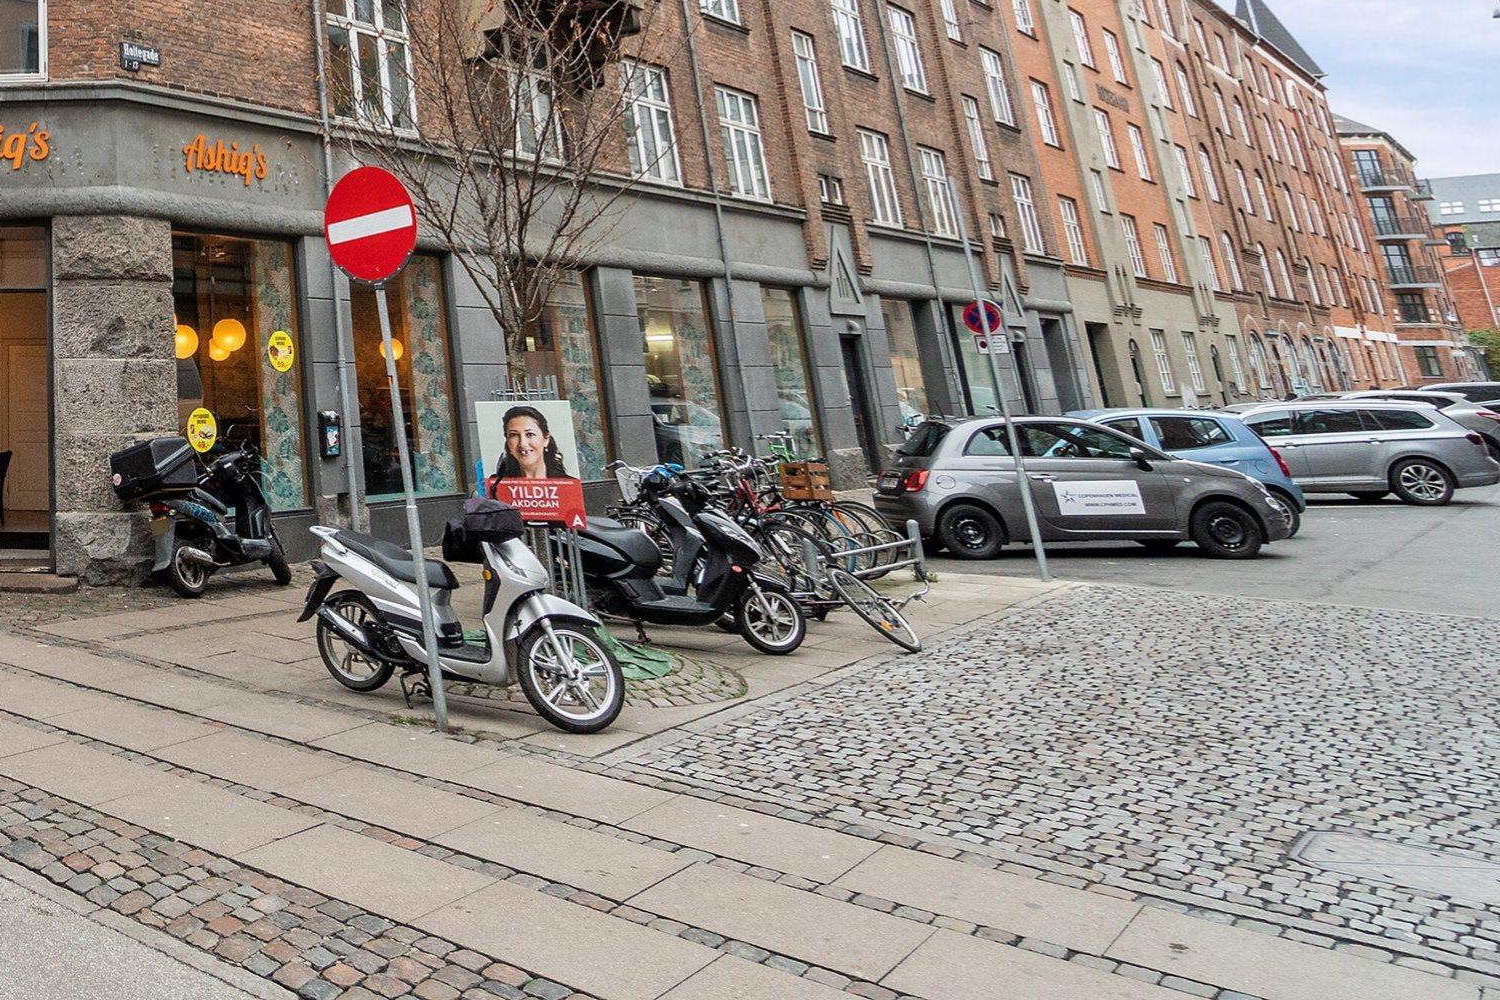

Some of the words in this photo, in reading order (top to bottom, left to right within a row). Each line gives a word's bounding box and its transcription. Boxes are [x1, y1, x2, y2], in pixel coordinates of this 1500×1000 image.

[182, 133, 268, 187] Ashiq's
[507, 486, 559, 499] YILDIZ
[511, 500, 560, 508] AKDOGAN
[572, 514, 585, 527] A
